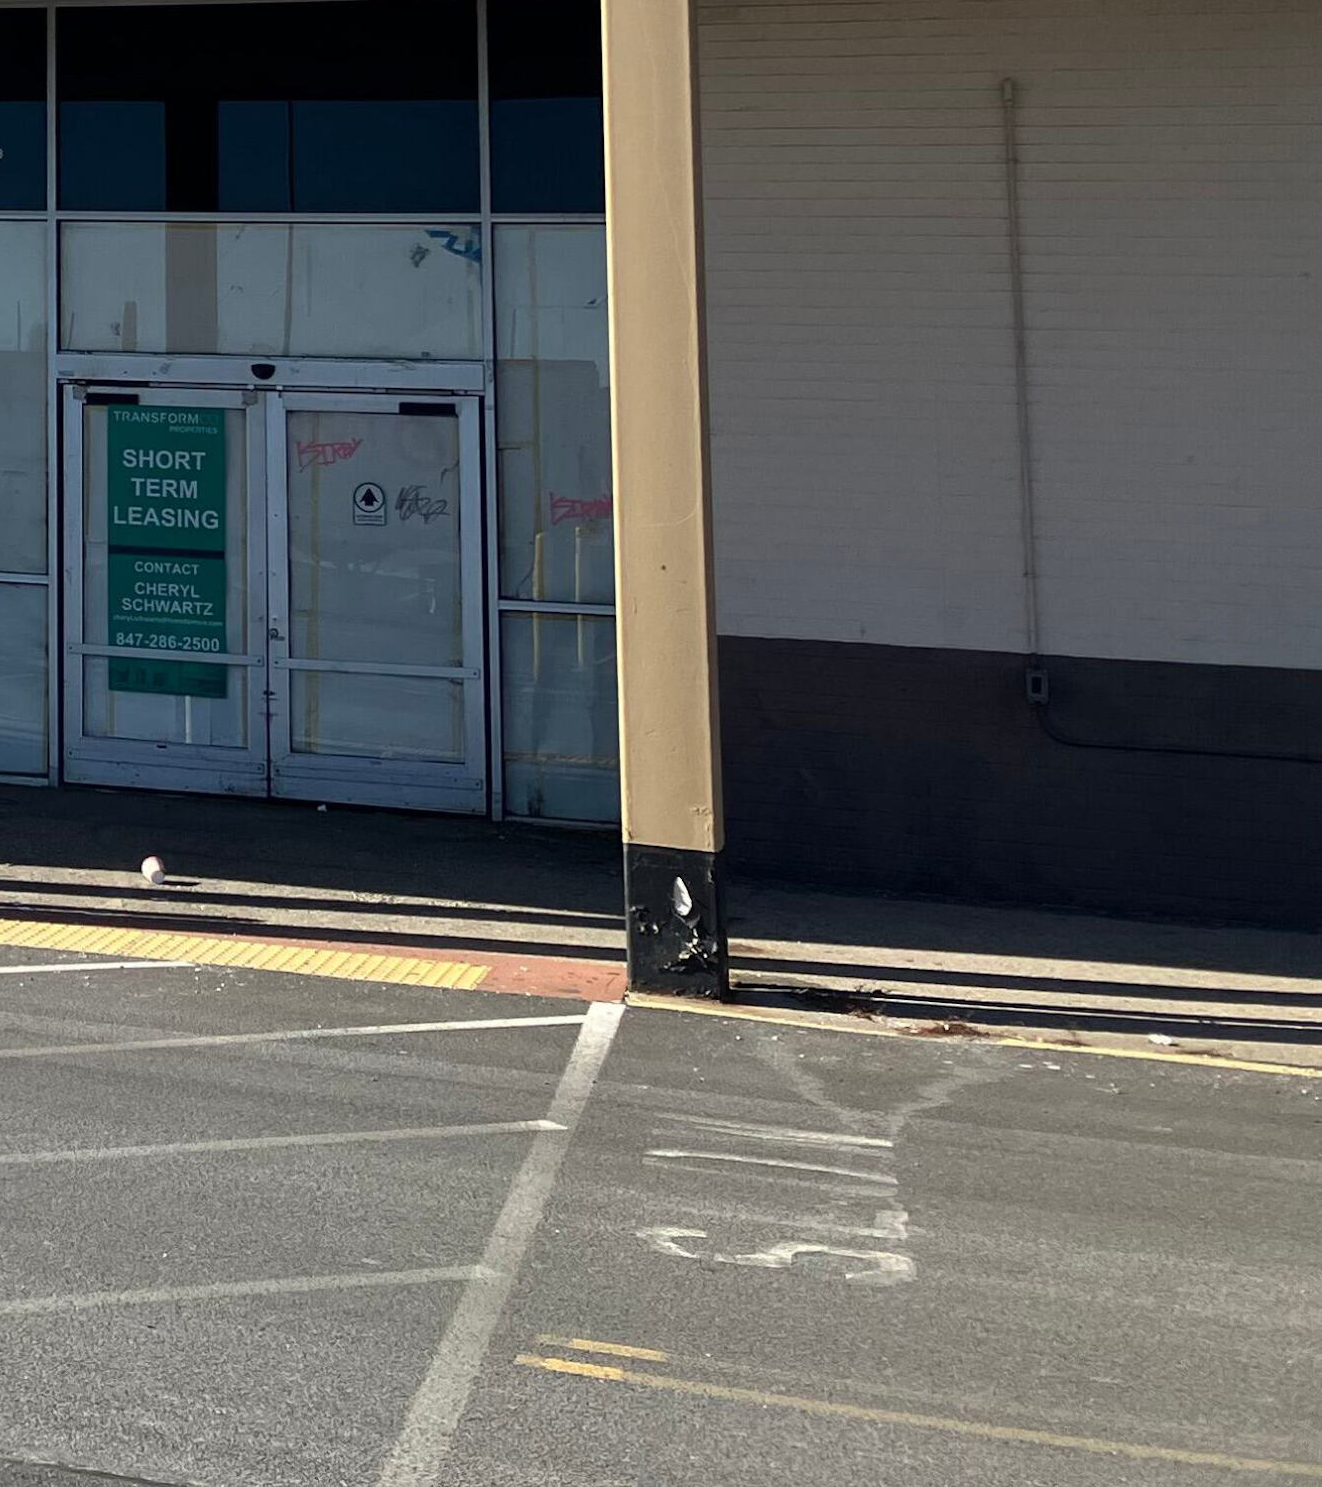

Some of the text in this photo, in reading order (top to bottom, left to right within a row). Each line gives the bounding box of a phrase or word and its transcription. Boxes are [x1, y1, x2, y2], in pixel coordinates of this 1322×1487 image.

[123, 449, 206, 470] SHORT
[130, 477, 198, 499] TERM
[113, 506, 219, 529] LEASING
[134, 561, 200, 575] CONTACT
[134, 582, 201, 598] CHERYL
[121, 598, 214, 616] SCHWARTZ
[116, 632, 220, 652] 847-286-2500
